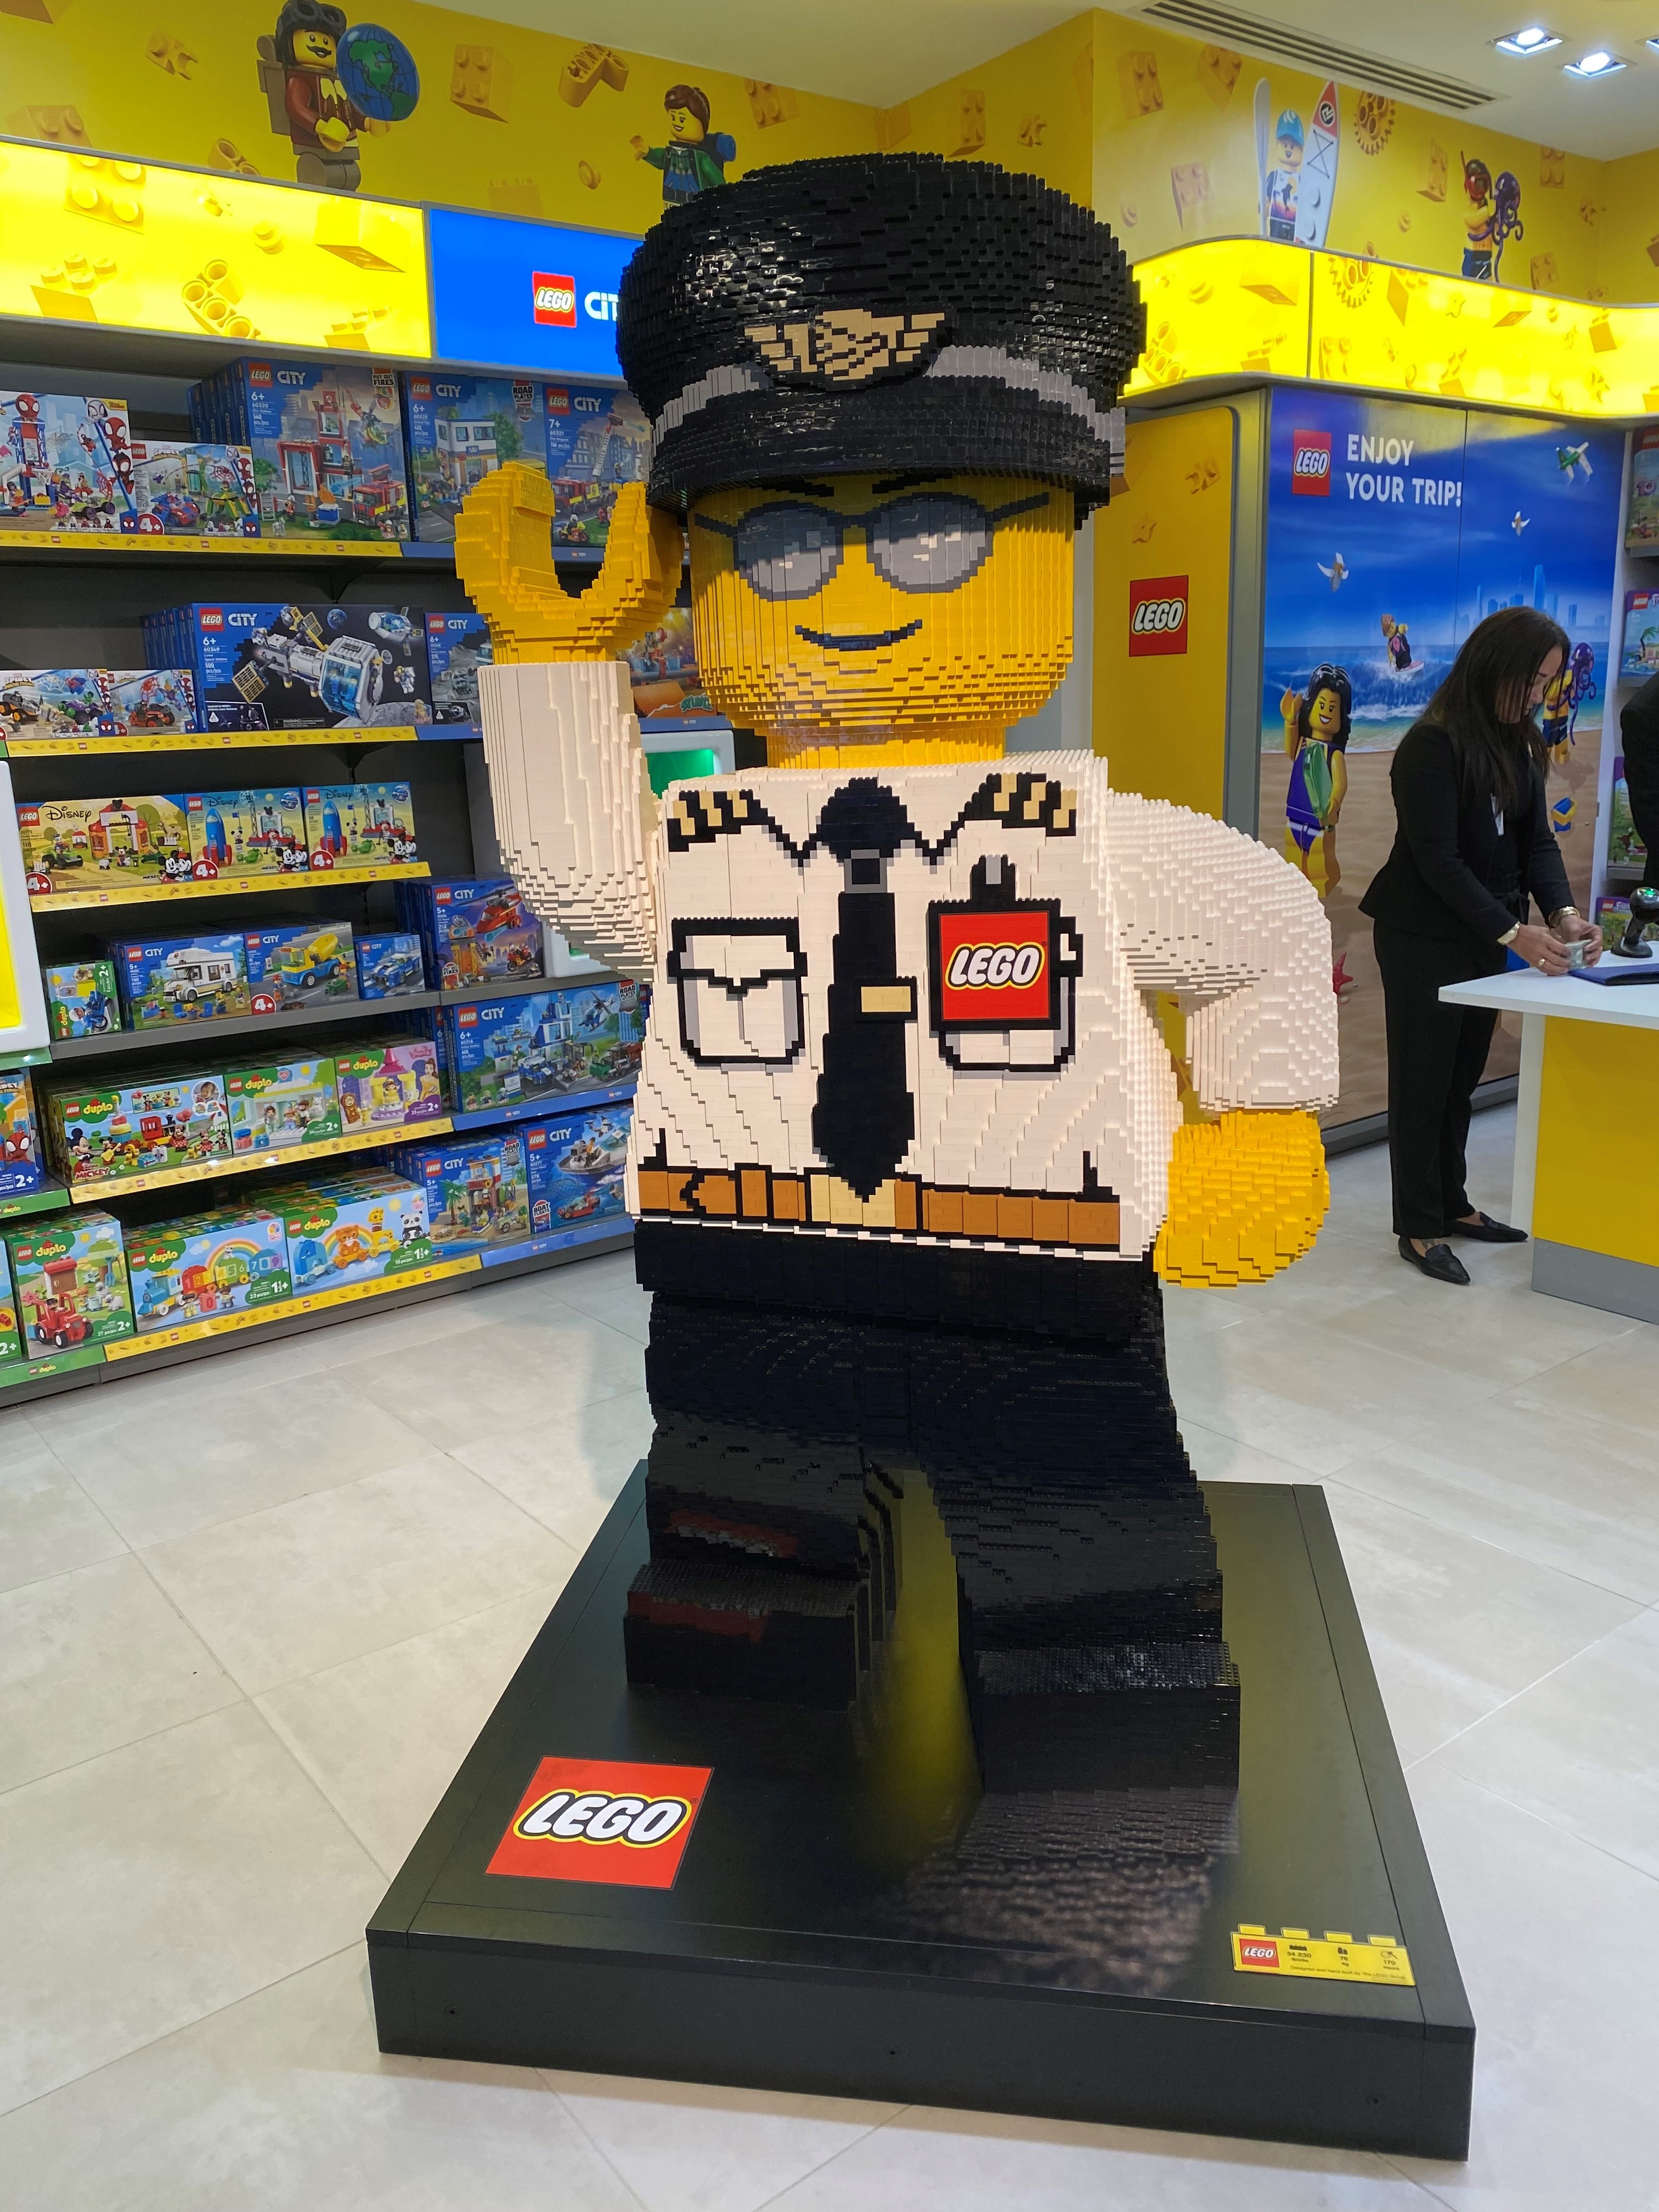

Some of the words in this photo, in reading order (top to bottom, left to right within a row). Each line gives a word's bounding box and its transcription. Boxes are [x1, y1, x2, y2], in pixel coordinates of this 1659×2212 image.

[535, 289, 573, 311] LEGO
[584, 291, 618, 321] CIT
[251, 370, 271, 379] LEGO
[276, 370, 306, 385] CITY
[251, 391, 264, 401] 6+
[413, 385, 431, 393] LEGO
[435, 384, 461, 398] CITY
[413, 404, 425, 413] 6+
[549, 397, 567, 407] LEGO
[573, 396, 602, 412] CITY
[549, 419, 561, 428] 7+
[1295, 449, 1329, 475] LEGO
[1347, 433, 1415, 466] ENJOY
[1346, 472, 1404, 503] YOUR
[1412, 477, 1462, 507] TRIP!
[139, 517, 161, 532] 4+
[201, 614, 222, 624] LEGO
[228, 613, 257, 626] CITY
[1133, 600, 1184, 633] LEGO
[448, 619, 468, 629] CITY
[203, 636, 217, 645] 6+
[313, 854, 332, 866] 4+
[196, 864, 216, 877] 4+
[27, 877, 48, 890] 4+
[454, 889, 475, 900] CITY
[263, 934, 279, 944] CITY
[145, 947, 163, 957] CITY
[99, 965, 109, 977] 2+
[948, 945, 1042, 988] LEGO
[619, 985, 636, 994] ROAD
[254, 998, 273, 1011] 4+
[460, 1013, 477, 1022] LEGO
[481, 1007, 505, 1020] CITY
[353, 1059, 378, 1070] duplo
[245, 1077, 273, 1090] duplo
[83, 1102, 114, 1115] duplo
[427, 1103, 439, 1111] 2+
[326, 1122, 338, 1131] 2+
[529, 1135, 546, 1144] LEGO
[549, 1128, 572, 1142] CITY
[504, 1142, 520, 1152] ROAD
[427, 1164, 441, 1172] LEGO
[444, 1157, 464, 1170] CITY
[75, 1167, 110, 1180] MICKEY
[14, 1174, 34, 1188] 2+
[533, 1203, 550, 1213] BOAT
[534, 1209, 550, 1217] FLOATS
[304, 1218, 331, 1231] duplo
[19, 1249, 32, 1257] LEGO
[36, 1243, 67, 1258] duplo
[149, 1250, 178, 1263] duplo
[228, 1266, 235, 1276] 5
[239, 1263, 245, 1272] 6
[251, 1261, 257, 1270] 7
[272, 1256, 280, 1267] 9
[194, 1276, 202, 1285] 2
[117, 1321, 131, 1331] 2+
[40, 1364, 57, 1373] duplo
[518, 1791, 689, 1845] LEGO
[1243, 1946, 1276, 1959] LEGO
